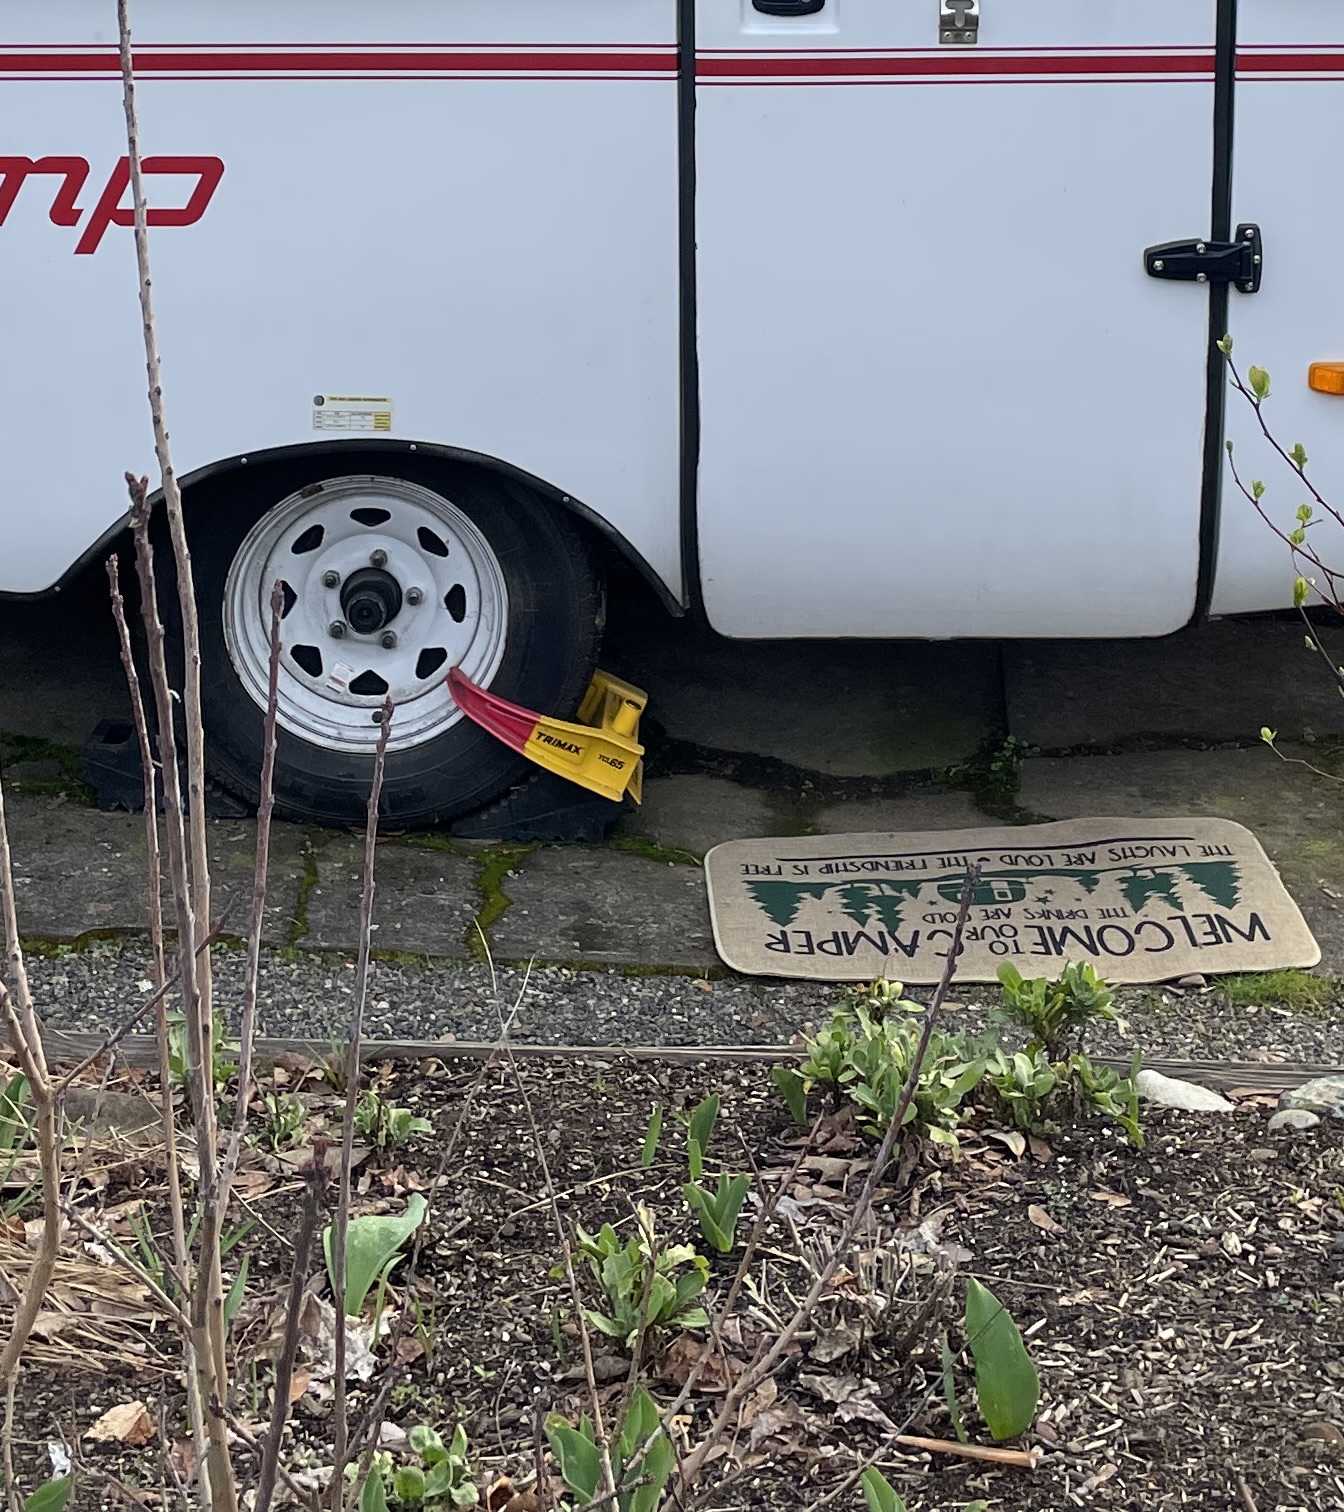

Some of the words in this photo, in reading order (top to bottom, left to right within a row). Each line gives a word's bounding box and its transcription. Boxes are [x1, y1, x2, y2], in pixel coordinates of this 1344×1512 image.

[535, 731, 583, 756] TRIMAX
[1109, 845, 1190, 861] LAUGHS
[1199, 845, 1234, 856] THE
[937, 855, 969, 868] THE
[1000, 854, 1054, 867] LOUD
[1062, 851, 1096, 865] ARE
[740, 863, 782, 875] FREE
[792, 864, 809, 875] IS
[819, 857, 928, 874] FRIENDSHIP
[980, 907, 1012, 921] ARE
[1023, 908, 1088, 921] DRINKS
[1096, 907, 1130, 918] THE
[965, 923, 1018, 941] OUR
[1024, 912, 1271, 956] WELCOME
[764, 928, 965, 958] CAMPER
[988, 940, 1024, 955] TO
